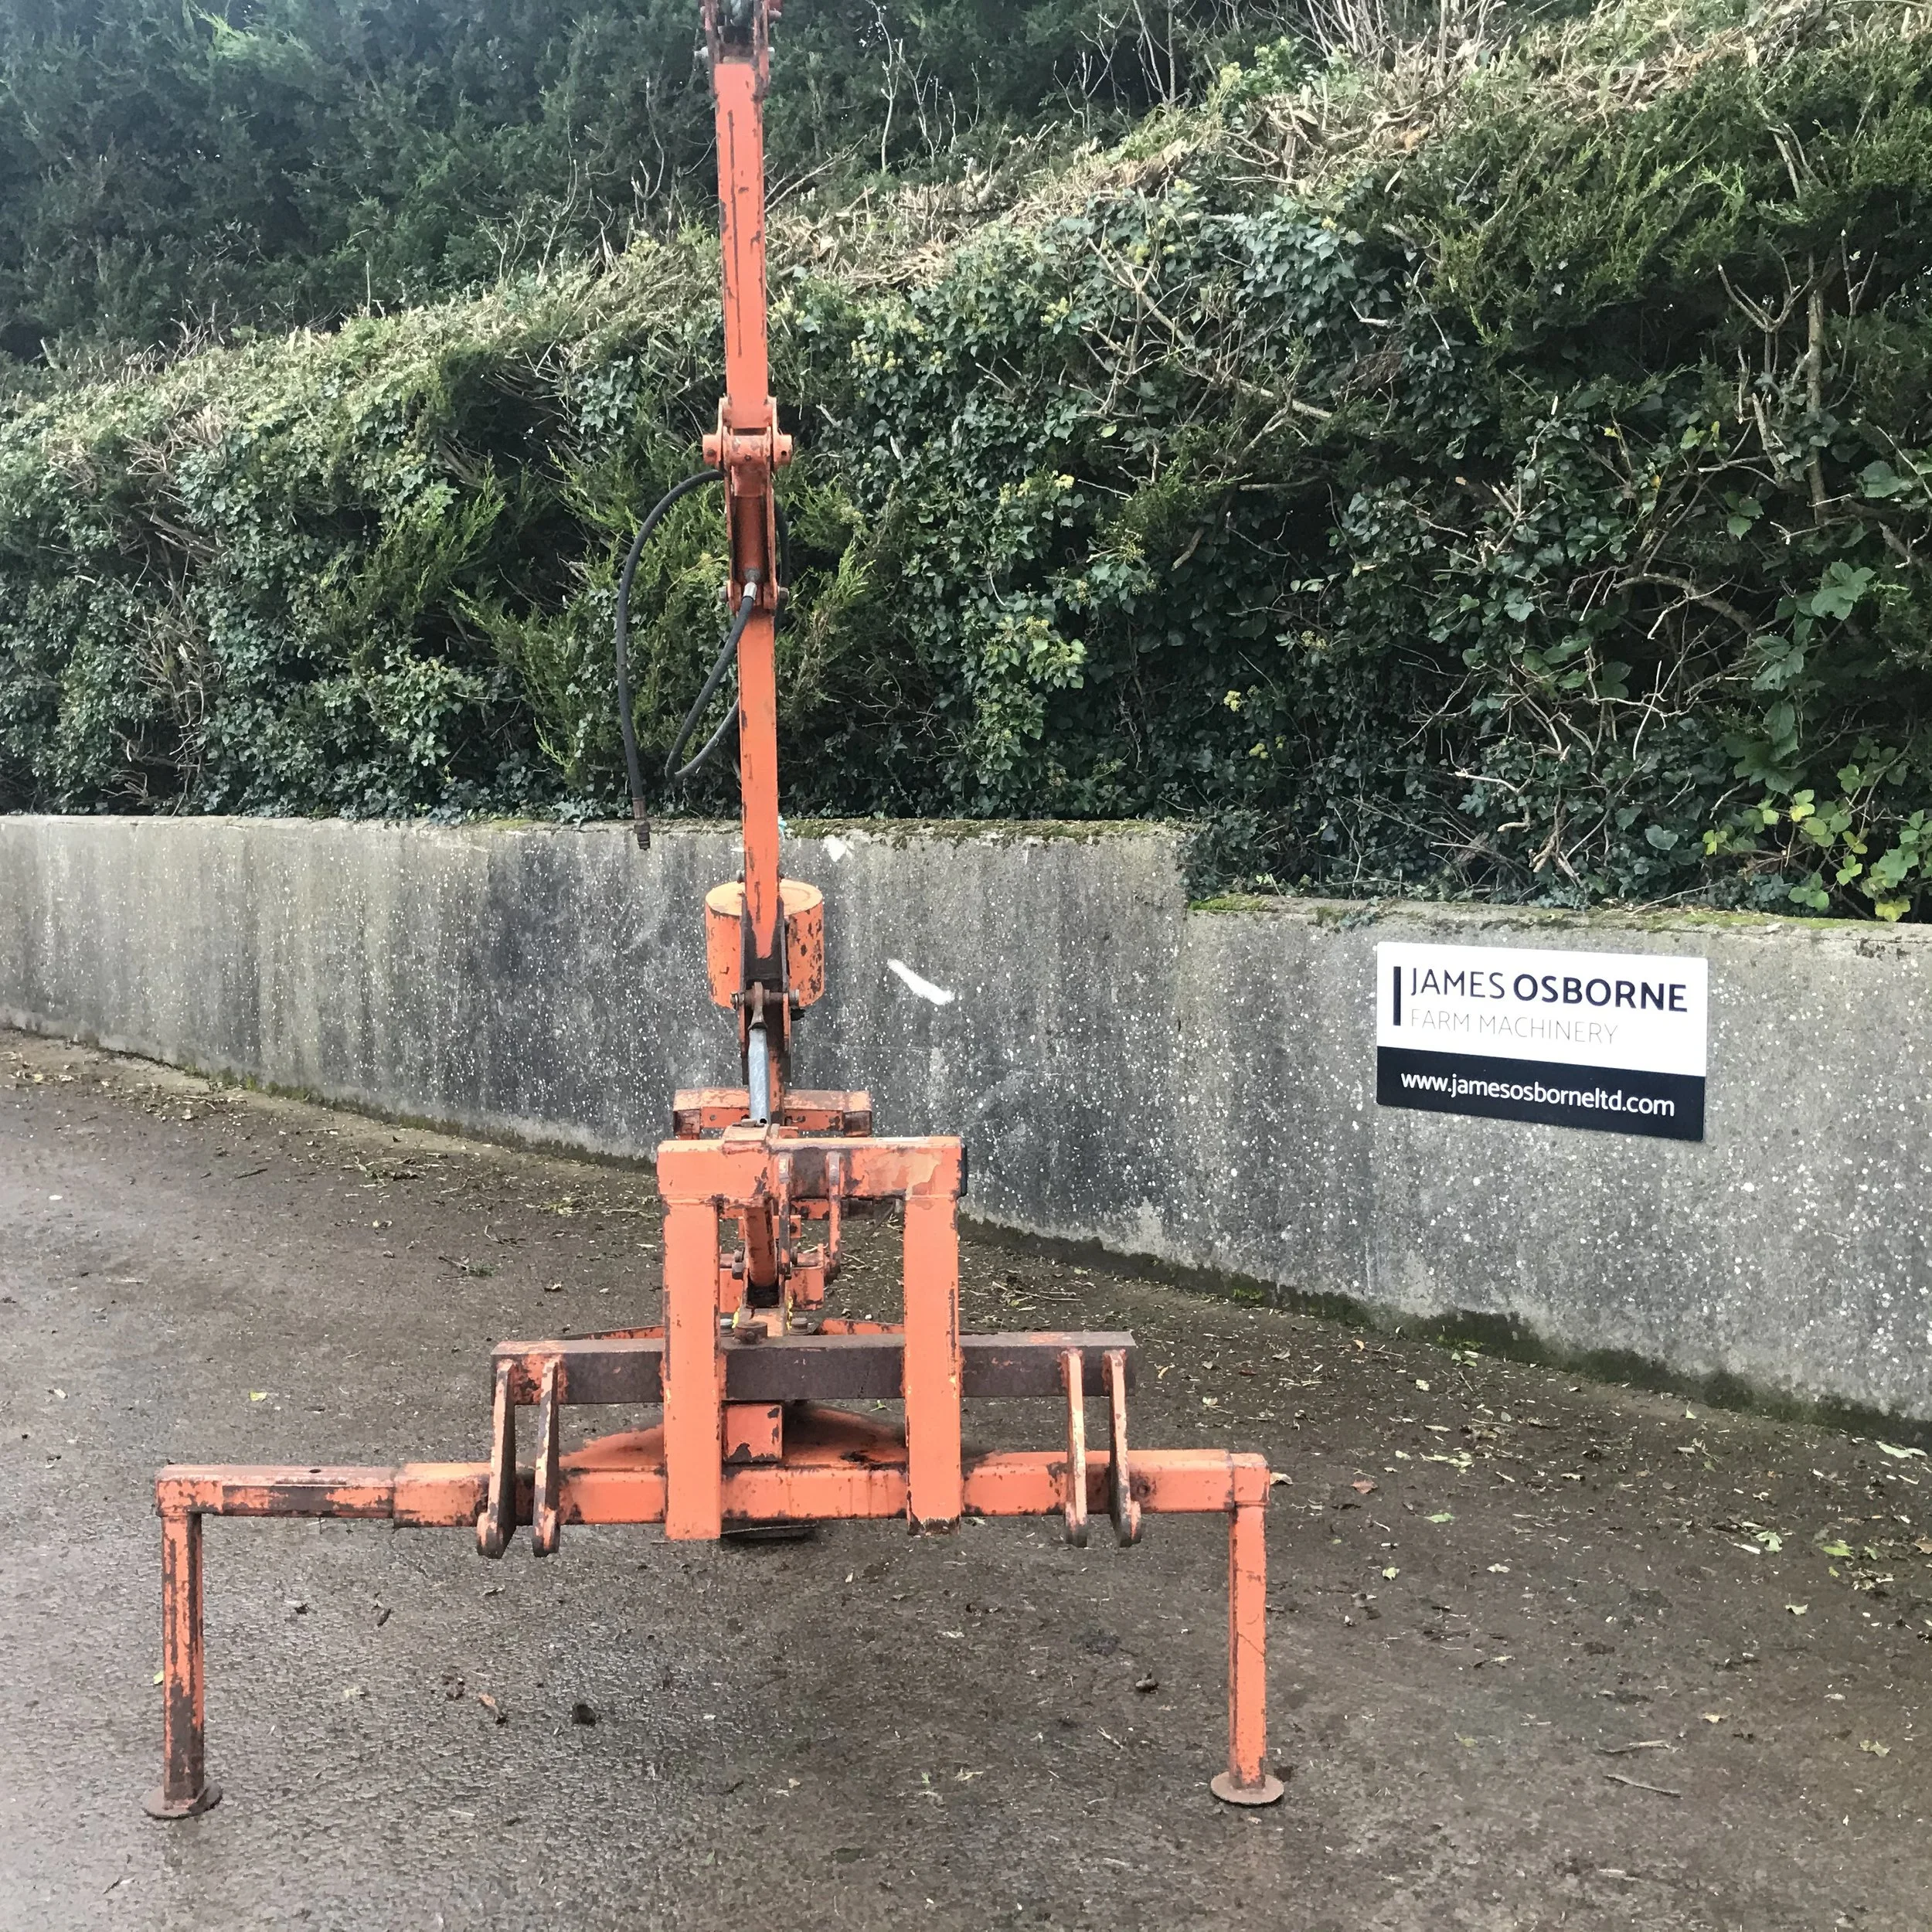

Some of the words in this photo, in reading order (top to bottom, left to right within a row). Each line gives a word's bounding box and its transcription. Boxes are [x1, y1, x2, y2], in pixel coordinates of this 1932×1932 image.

[1410, 968, 1505, 999] JAMES
[1512, 973, 1688, 1012] OSBORNE
[1410, 1009, 1470, 1032] FARM
[1479, 1014, 1618, 1044] MACHINERY
[1400, 1072, 1675, 1117] www.jamesosborneltd.com
